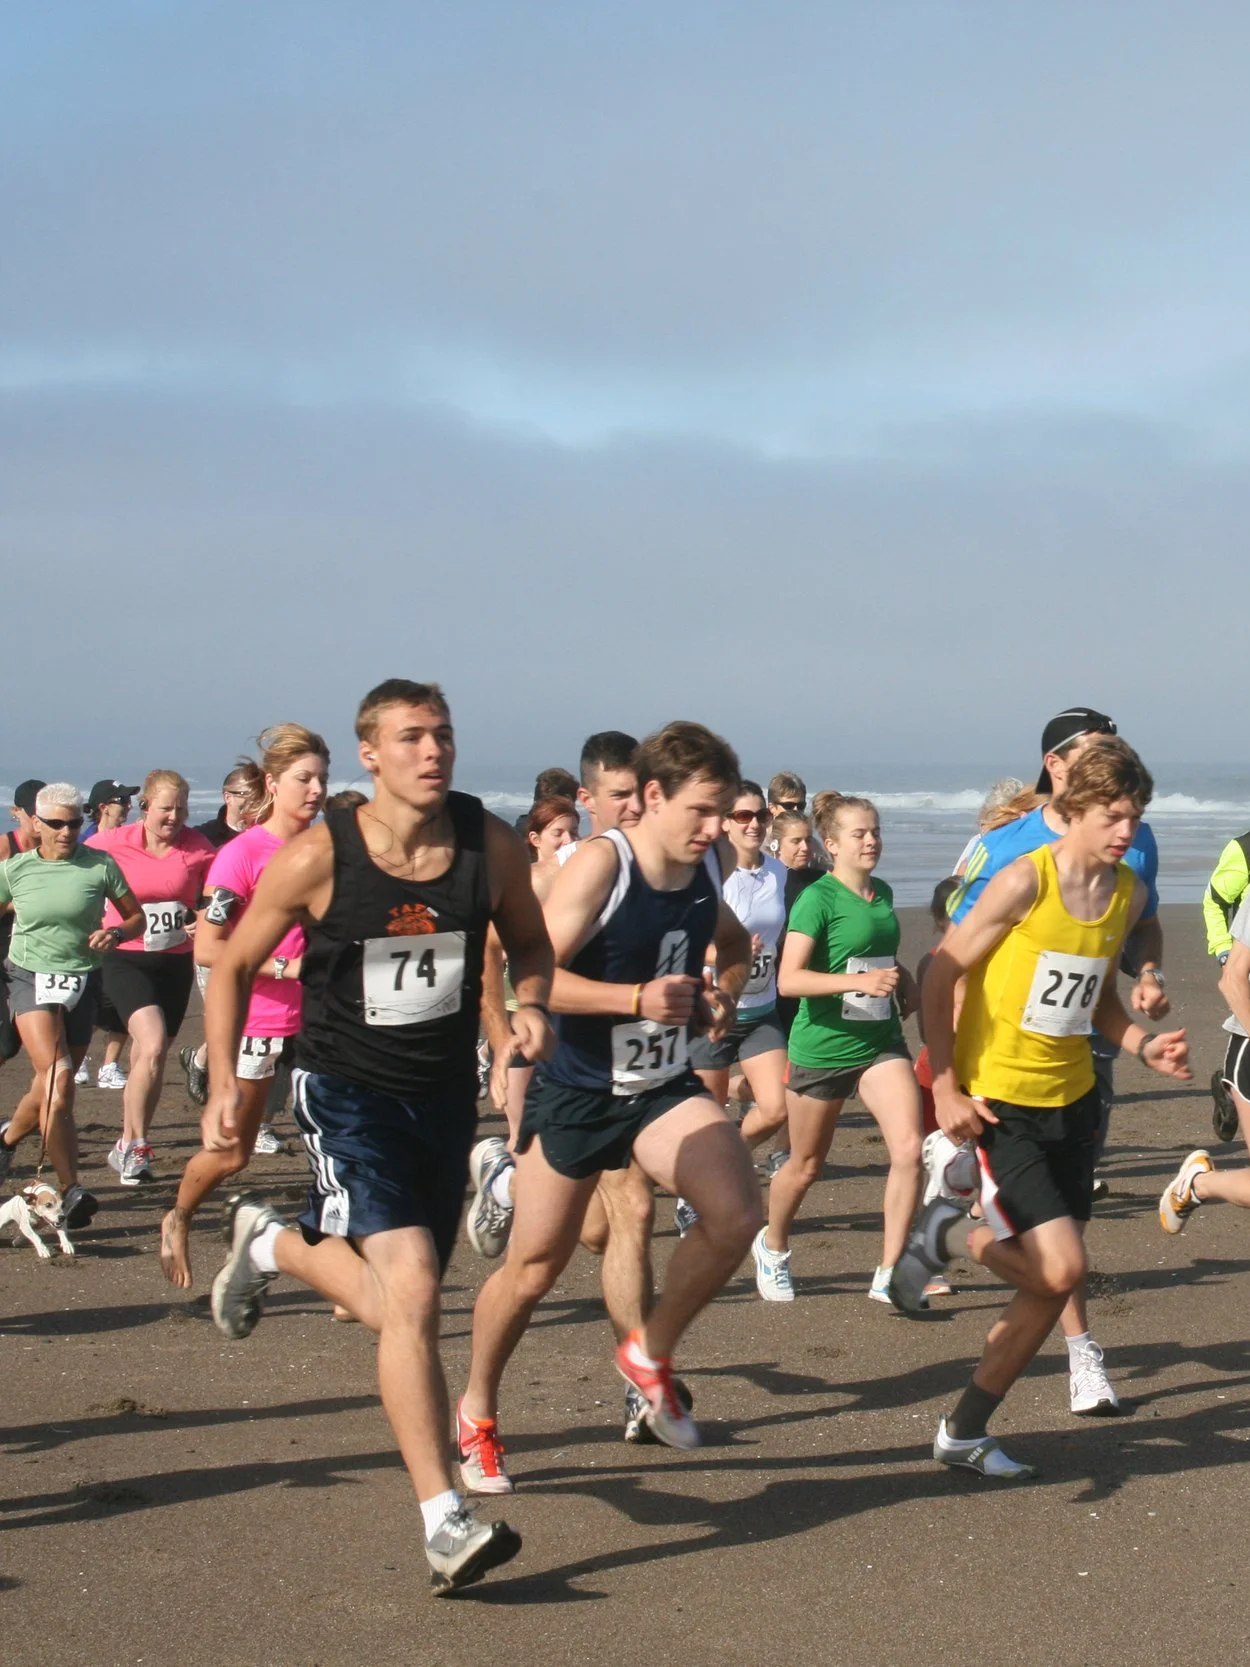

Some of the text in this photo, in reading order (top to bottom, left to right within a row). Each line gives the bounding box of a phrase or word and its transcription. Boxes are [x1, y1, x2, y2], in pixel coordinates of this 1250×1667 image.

[149, 910, 183, 934] 296
[45, 973, 81, 992] 323
[390, 948, 436, 991] 74
[1040, 969, 1098, 1009] 278
[625, 1026, 679, 1071] 257
